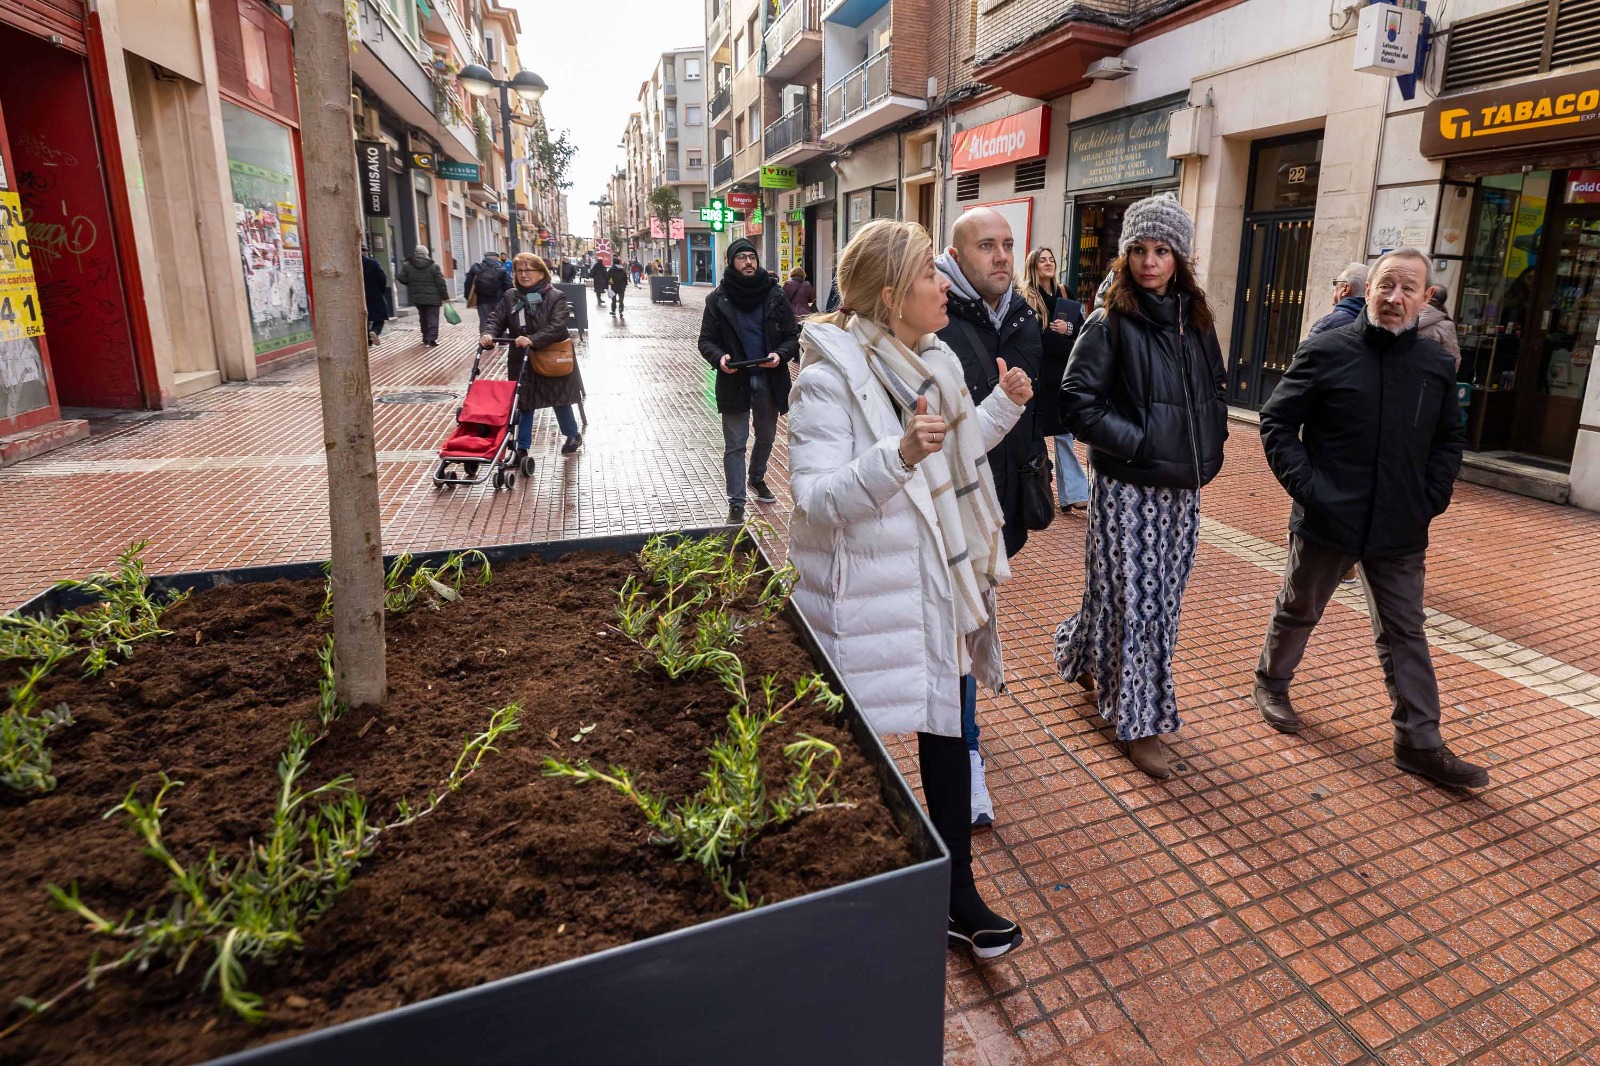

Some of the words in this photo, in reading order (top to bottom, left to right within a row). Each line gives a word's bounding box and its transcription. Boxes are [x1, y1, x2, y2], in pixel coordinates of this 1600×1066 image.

[1382, 49, 1401, 58] Apuestas
[1381, 56, 1395, 64] Estado
[1481, 89, 1600, 127] TABACO
[968, 130, 1026, 161] Alcampo
[367, 147, 381, 192] MISAKO
[1127, 160, 1147, 169] CORTE
[1290, 168, 1304, 182] 22
[1571, 181, 1595, 192] Gold
